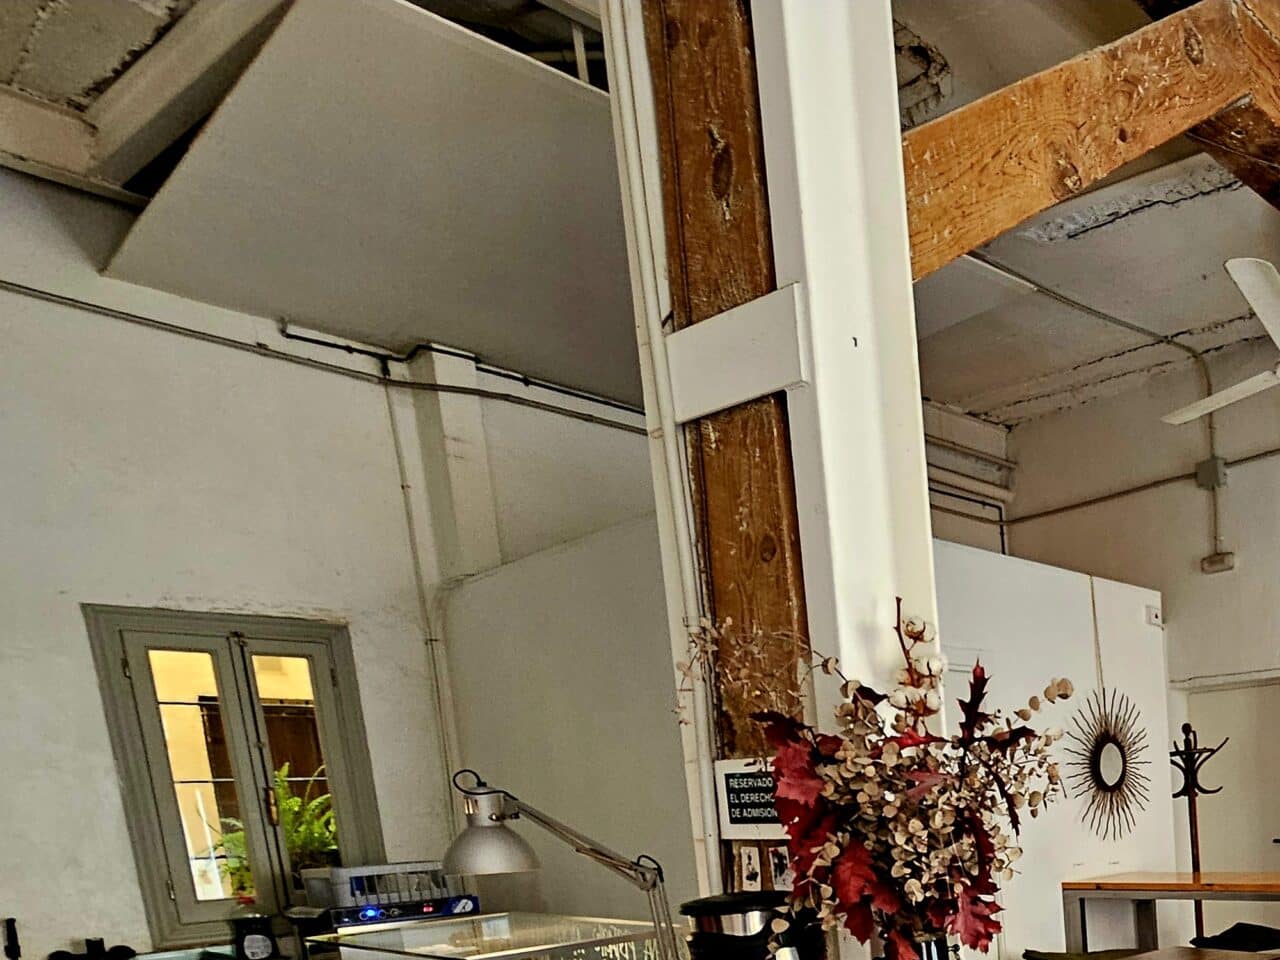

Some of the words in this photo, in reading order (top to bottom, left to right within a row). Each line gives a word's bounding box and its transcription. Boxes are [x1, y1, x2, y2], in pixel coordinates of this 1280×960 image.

[728, 777, 774, 789] RESERVADO
[729, 793, 740, 803] EL
[731, 808, 741, 818] DE
